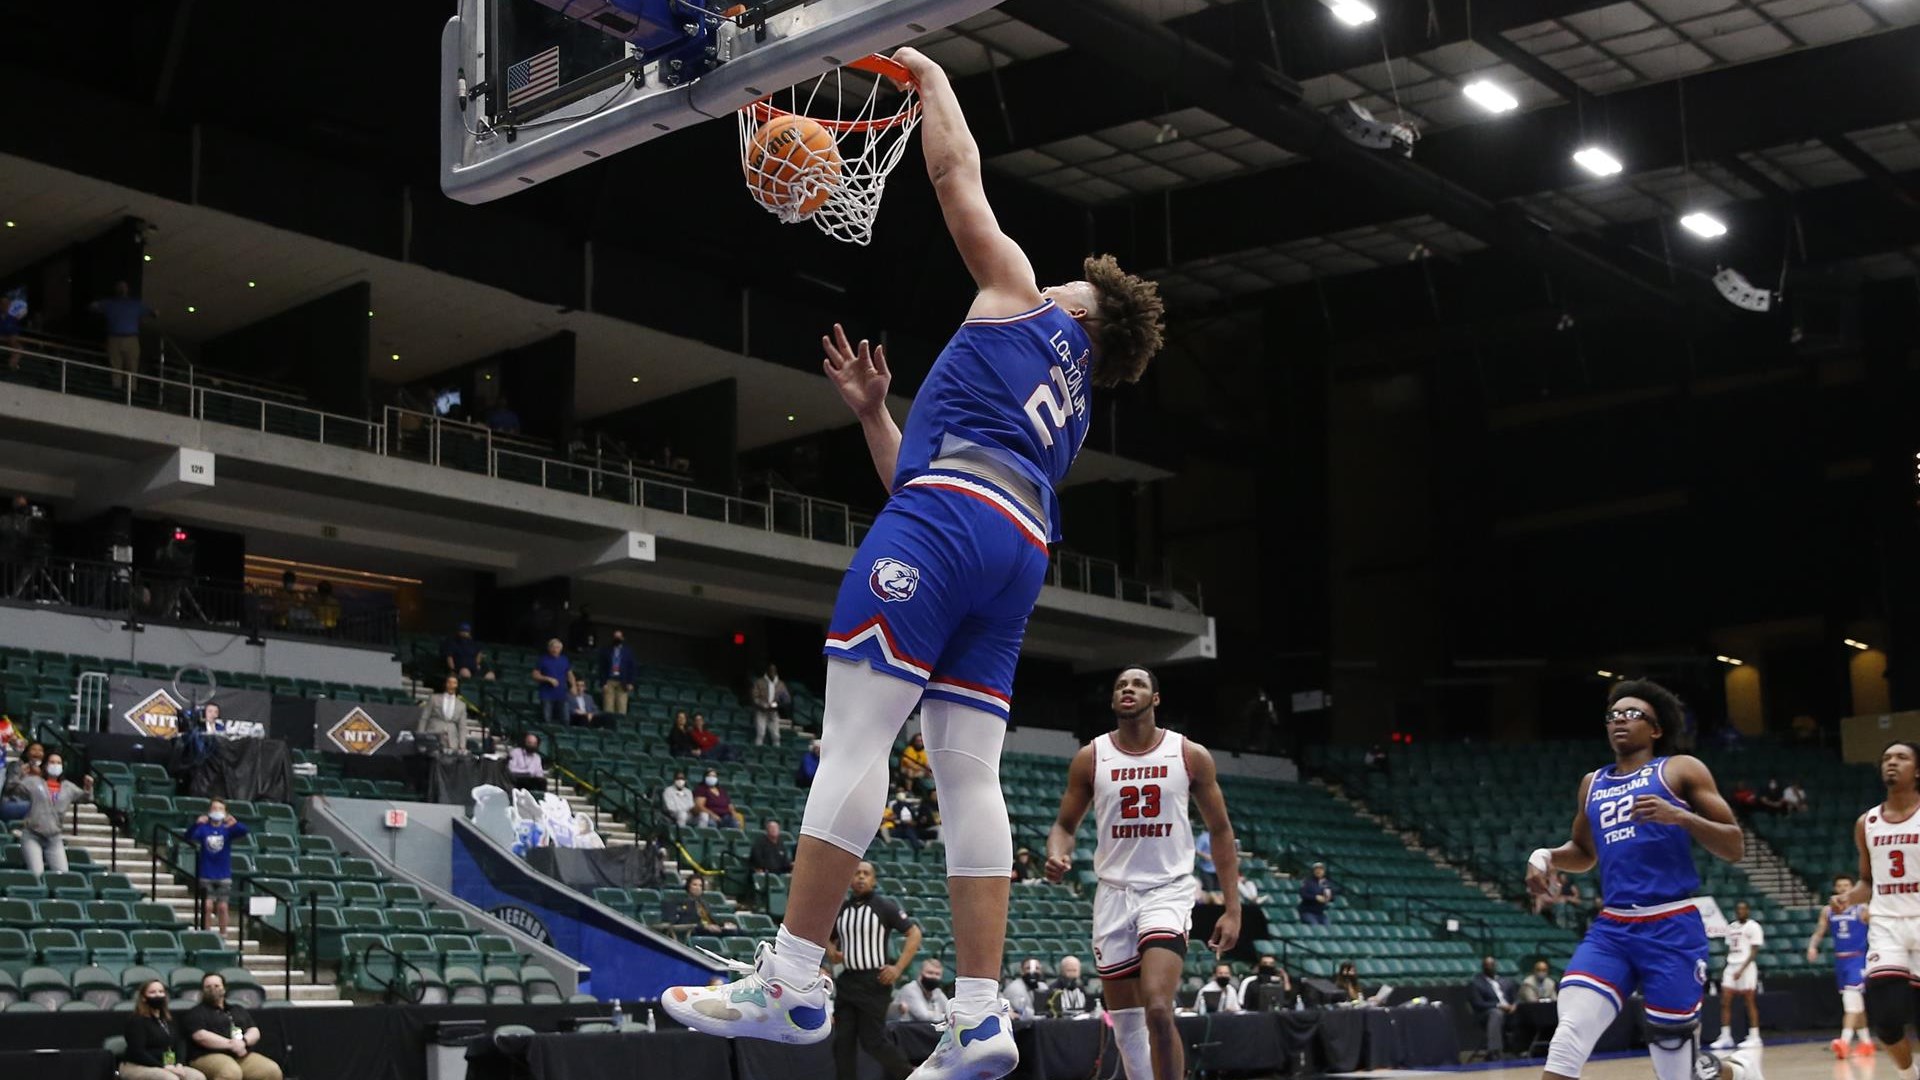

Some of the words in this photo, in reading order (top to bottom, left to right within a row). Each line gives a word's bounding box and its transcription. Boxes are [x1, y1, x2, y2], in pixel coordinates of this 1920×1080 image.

[1049, 329, 1084, 398] LOFTON
[1073, 393, 1086, 421] JR.
[1023, 365, 1074, 450] 2
[144, 713, 178, 728] NIT
[225, 719, 265, 739] USA
[343, 730, 376, 742] NIT
[1111, 765, 1168, 782] WESTERN
[1120, 784, 1161, 819] 23
[1600, 795, 1634, 829] 22
[1112, 823, 1173, 838] KENTUCKY
[1604, 825, 1636, 845] TECH
[1888, 850, 1906, 878] 3
